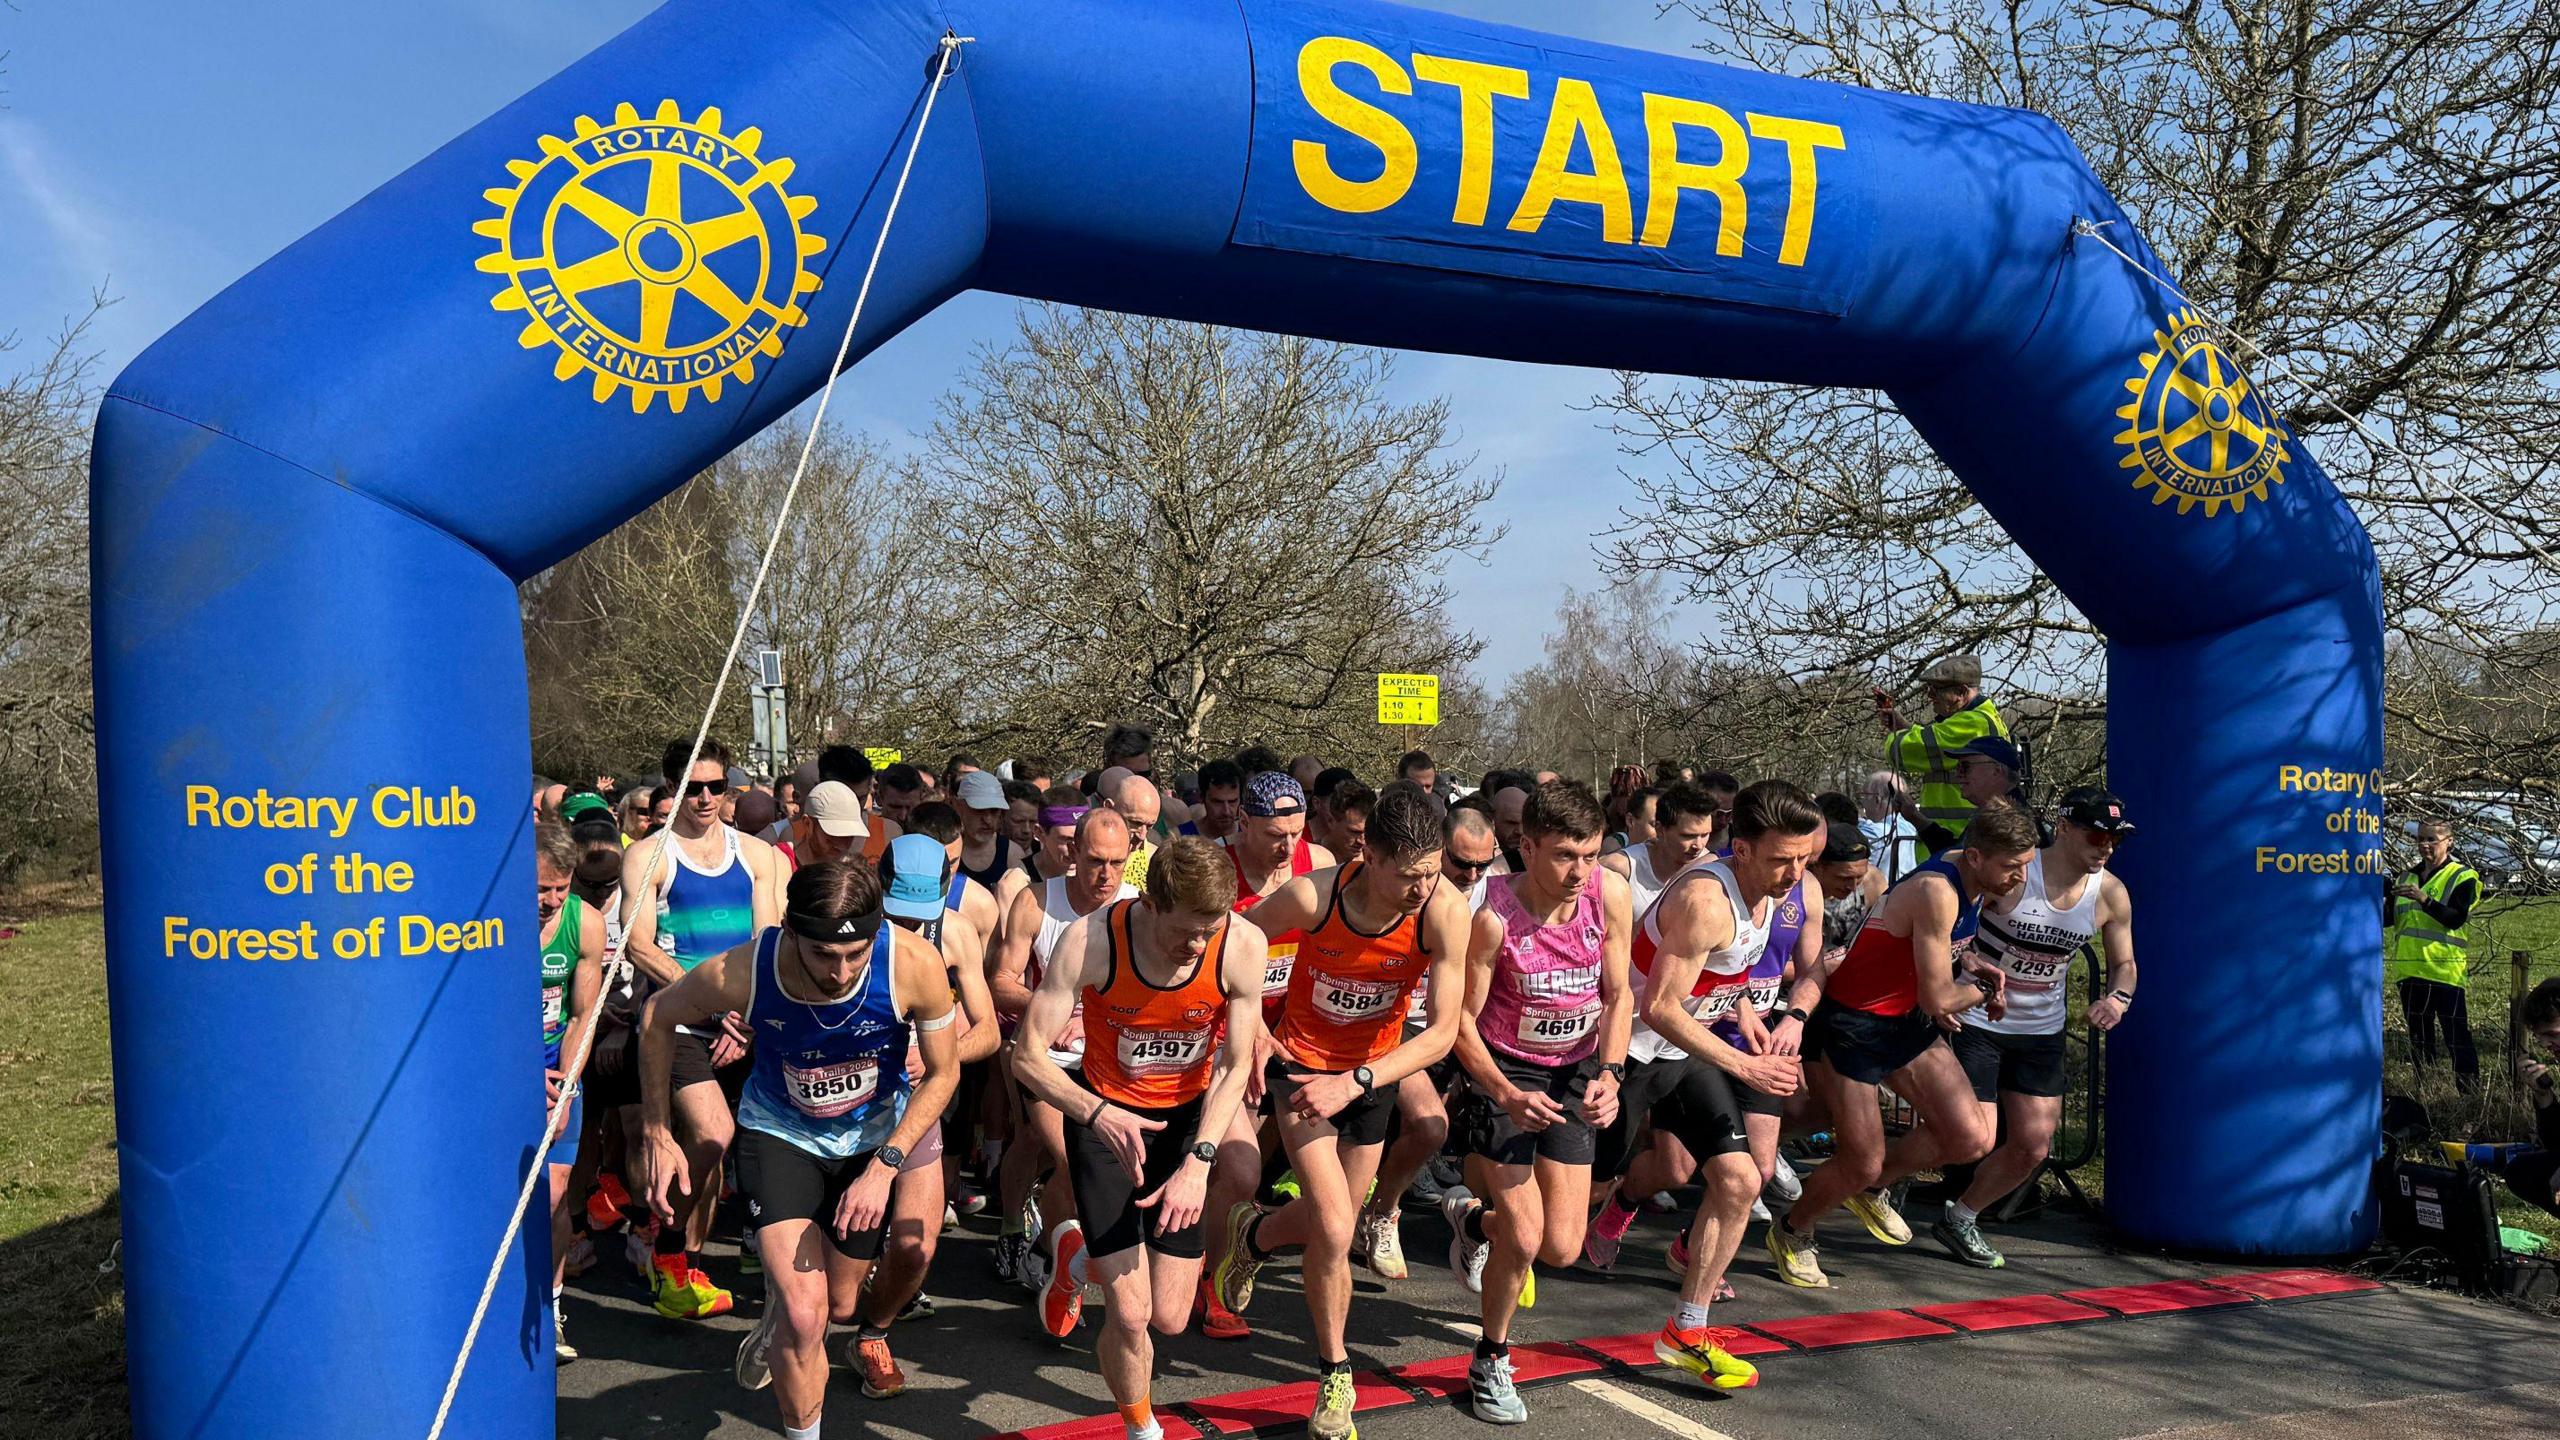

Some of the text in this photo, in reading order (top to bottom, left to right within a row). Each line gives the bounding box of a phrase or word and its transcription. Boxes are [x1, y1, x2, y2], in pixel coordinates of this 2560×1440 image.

[591, 127, 742, 170] ROTARY
[1292, 36, 1847, 267] START
[528, 283, 769, 383] INTERNATIONAL
[2144, 442, 2278, 496] INTERNATIONAL
[1382, 678, 1435, 688] EXPECTED
[1397, 687, 1422, 696] TIME
[1383, 701, 1404, 710] 1.10
[1383, 711, 1404, 720] 1.30
[2279, 765, 2367, 798] Rotary
[186, 784, 477, 838] Rotary Club
[2326, 807, 2380, 834] of the
[2256, 847, 2350, 874] Forest
[2354, 848, 2373, 875] of
[264, 852, 415, 895] of the
[164, 915, 505, 961] Forest of Dean
[928, 922, 937, 944] soa
[2016, 930, 2080, 951] HARRIERS
[2011, 959, 2056, 977] 4293
[1320, 972, 1349, 991] Spring
[1351, 981, 1377, 994] Trails
[1326, 989, 1384, 1010] 4584
[1525, 1007, 1555, 1020] Spring
[1558, 1008, 1581, 1019] Trails
[1123, 1028, 1155, 1041] Spring
[1158, 1031, 1184, 1040] Trails
[1533, 1016, 1587, 1036] 4691
[1131, 1040, 1196, 1059] 4597
[818, 1066, 847, 1080] Trails
[797, 1073, 862, 1099] 3850
